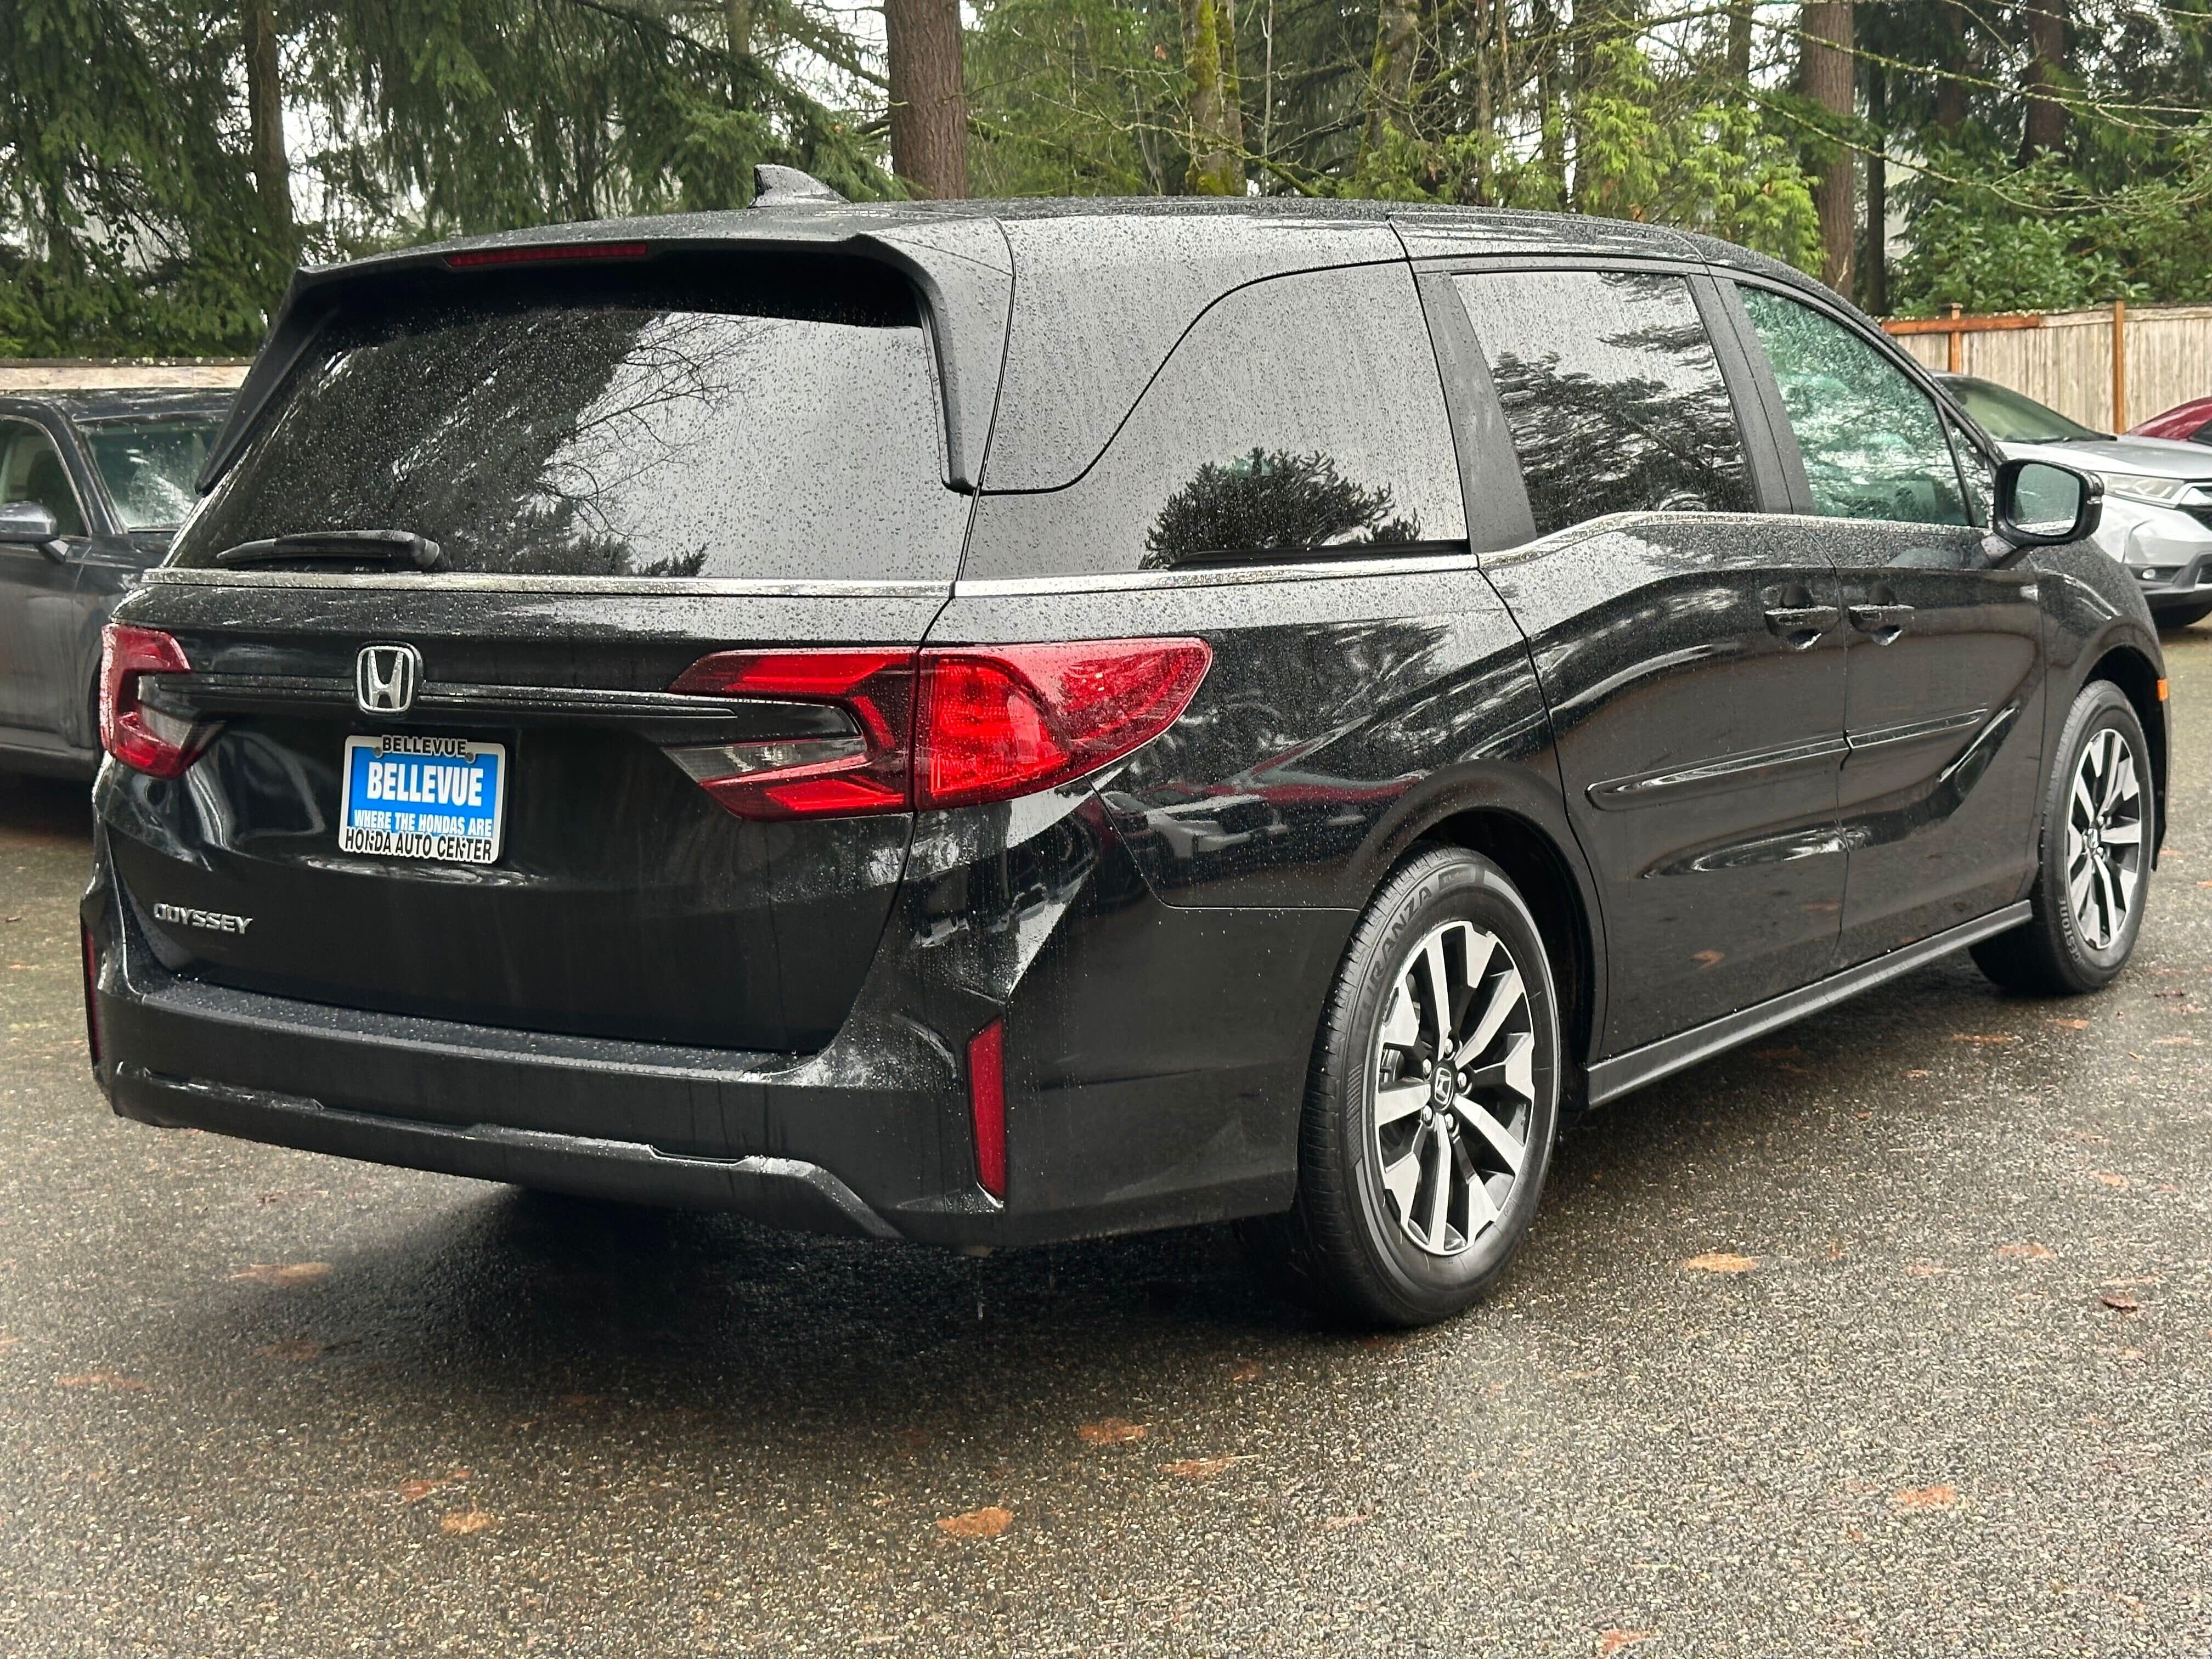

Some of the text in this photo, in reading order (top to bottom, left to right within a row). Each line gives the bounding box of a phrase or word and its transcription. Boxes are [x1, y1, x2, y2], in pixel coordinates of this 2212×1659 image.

[382, 736, 467, 756] BELLEVUE
[366, 761, 483, 806] BELLEVUE
[354, 809, 492, 837] WHERE THE HONDAS ARE
[345, 828, 492, 861] HONDA AUTO CENTER
[154, 903, 253, 934] ODYSSEY
